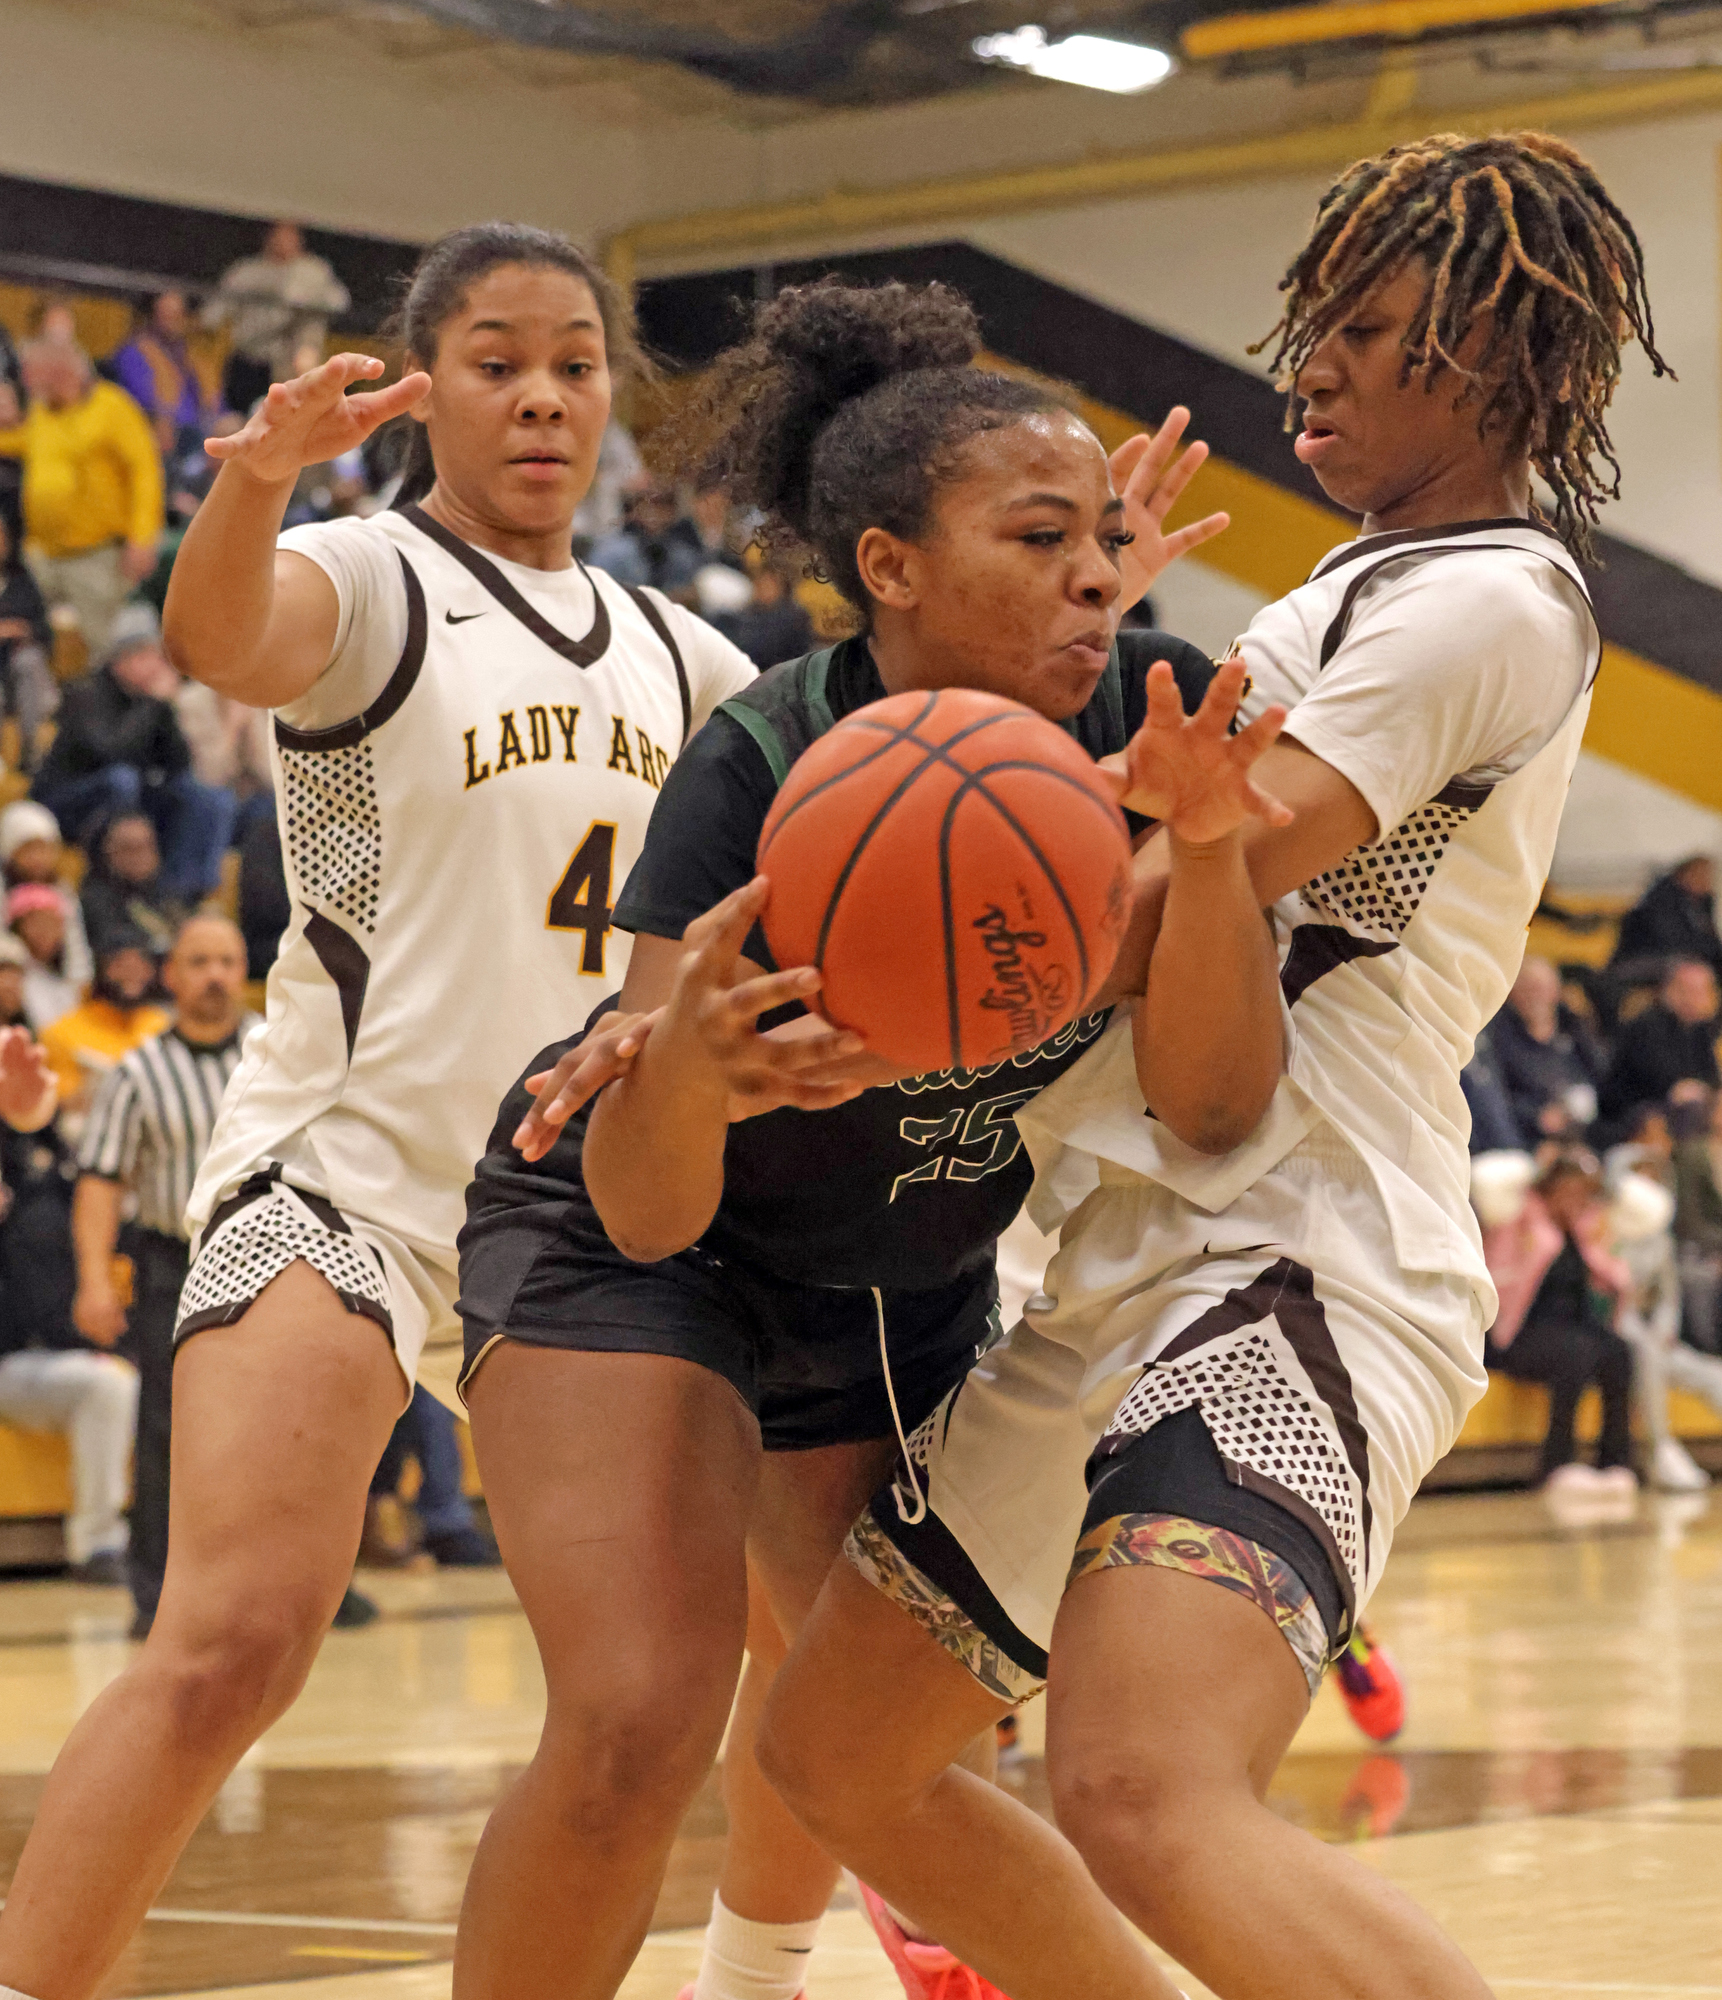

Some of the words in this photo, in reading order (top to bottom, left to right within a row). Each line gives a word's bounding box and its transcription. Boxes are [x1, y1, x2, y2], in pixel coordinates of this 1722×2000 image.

[463, 704, 580, 791] LADY
[606, 713, 675, 792] ARC
[544, 818, 618, 978] 4
